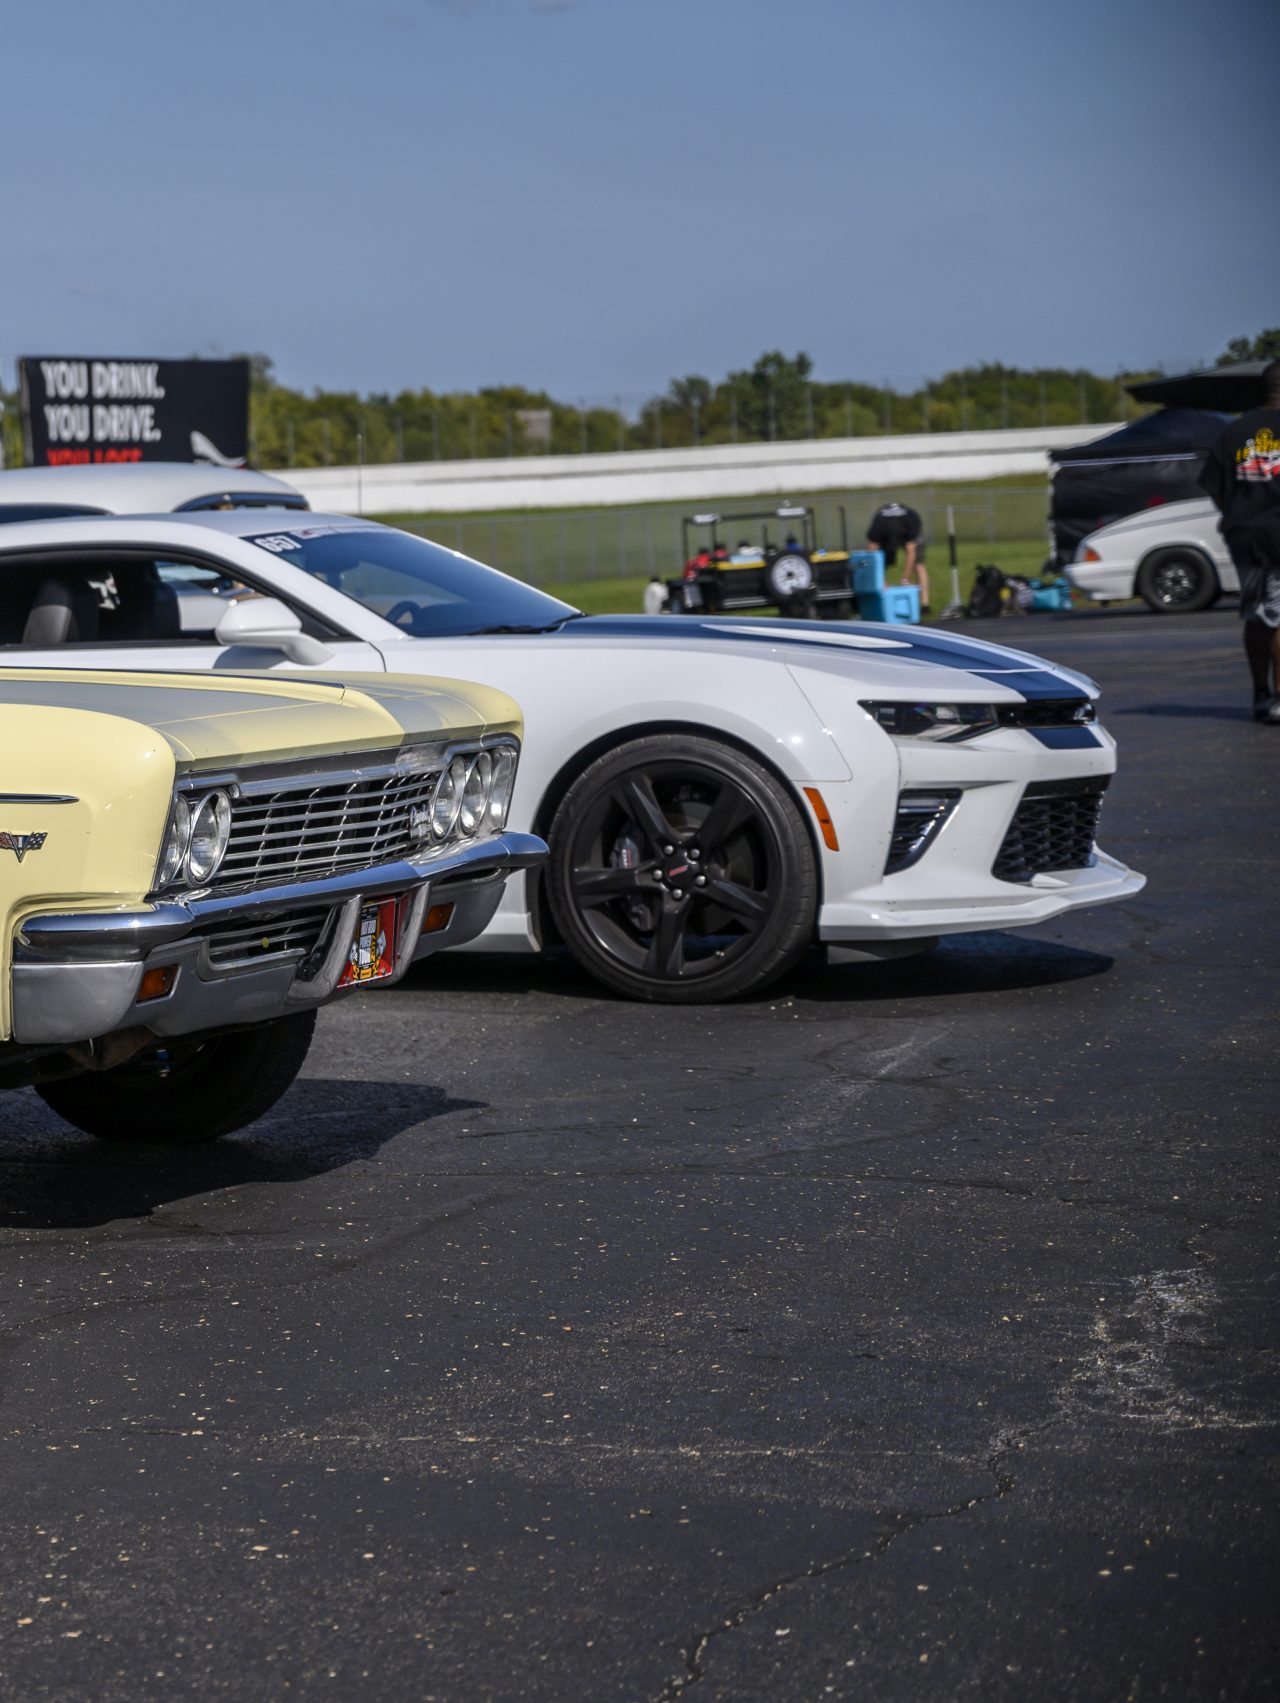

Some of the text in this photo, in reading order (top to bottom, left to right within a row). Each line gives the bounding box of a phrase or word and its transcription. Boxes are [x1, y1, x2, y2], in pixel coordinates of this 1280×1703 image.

[40, 360, 166, 399] YOU DRINK.
[43, 404, 162, 443] YOU DRIVE.
[254, 535, 302, 553] 657
